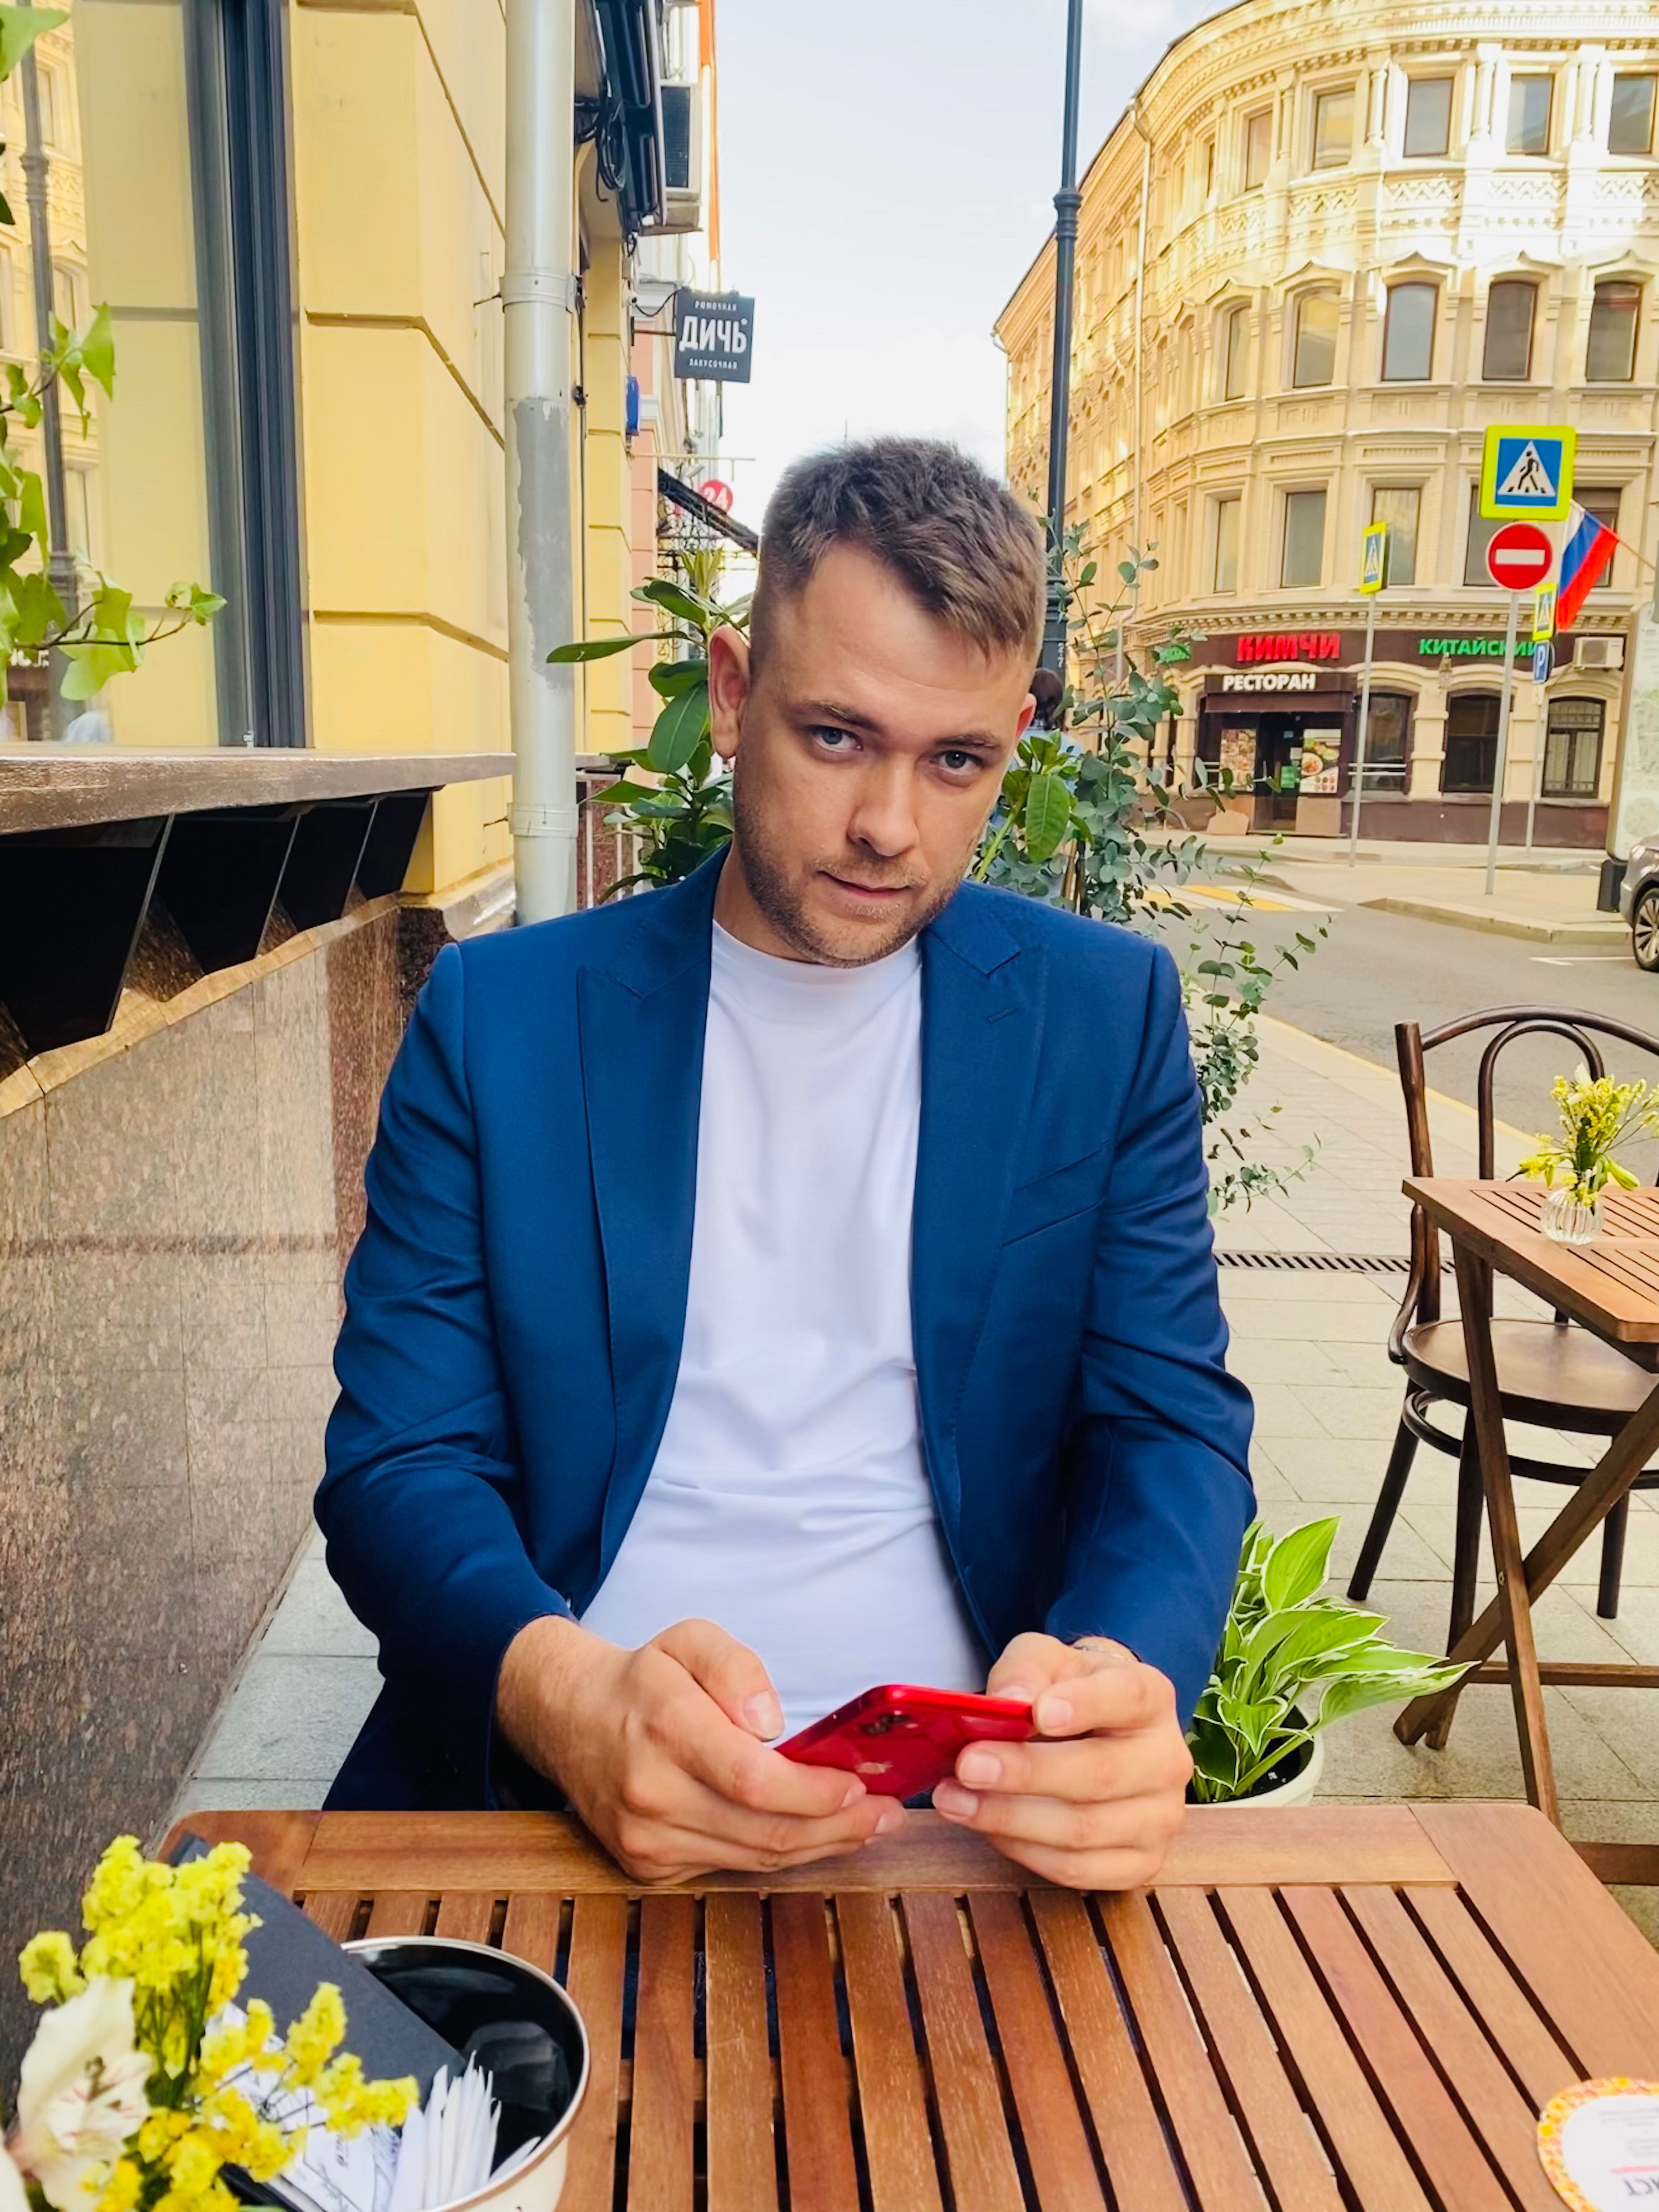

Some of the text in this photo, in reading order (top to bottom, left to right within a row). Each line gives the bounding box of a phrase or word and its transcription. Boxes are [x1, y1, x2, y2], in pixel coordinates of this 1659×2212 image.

[689, 358, 738, 370] ЗАКУСОЧНАЯ
[1237, 634, 1340, 662] КИМЧИ
[1223, 673, 1316, 692] РЕСТОРАН
